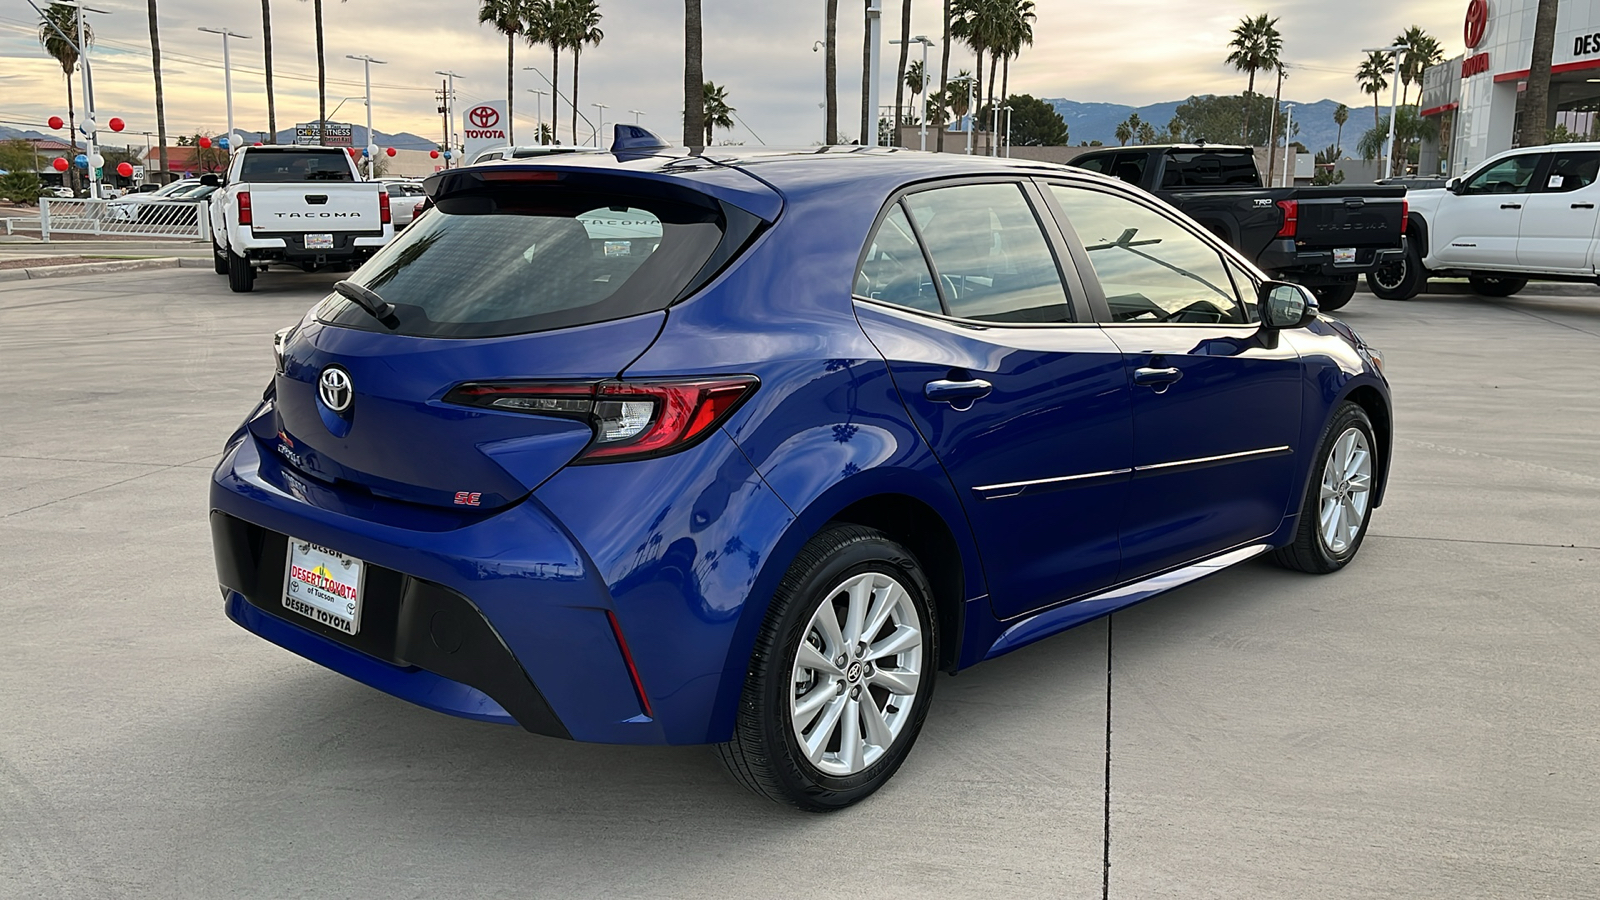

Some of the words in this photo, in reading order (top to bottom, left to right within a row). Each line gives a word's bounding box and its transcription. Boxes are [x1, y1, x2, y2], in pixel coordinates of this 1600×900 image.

[465, 130, 505, 139] TOYOTA
[1317, 223, 1387, 231] TACOMA
[453, 491, 482, 506] SE
[307, 542, 343, 558] TUCSON
[292, 566, 322, 587] DESERT
[324, 578, 357, 601] TOYOTA
[307, 587, 314, 595] of
[314, 590, 335, 603] Tucson
[285, 597, 315, 617] DESERT
[317, 610, 352, 632] TOYOTA
